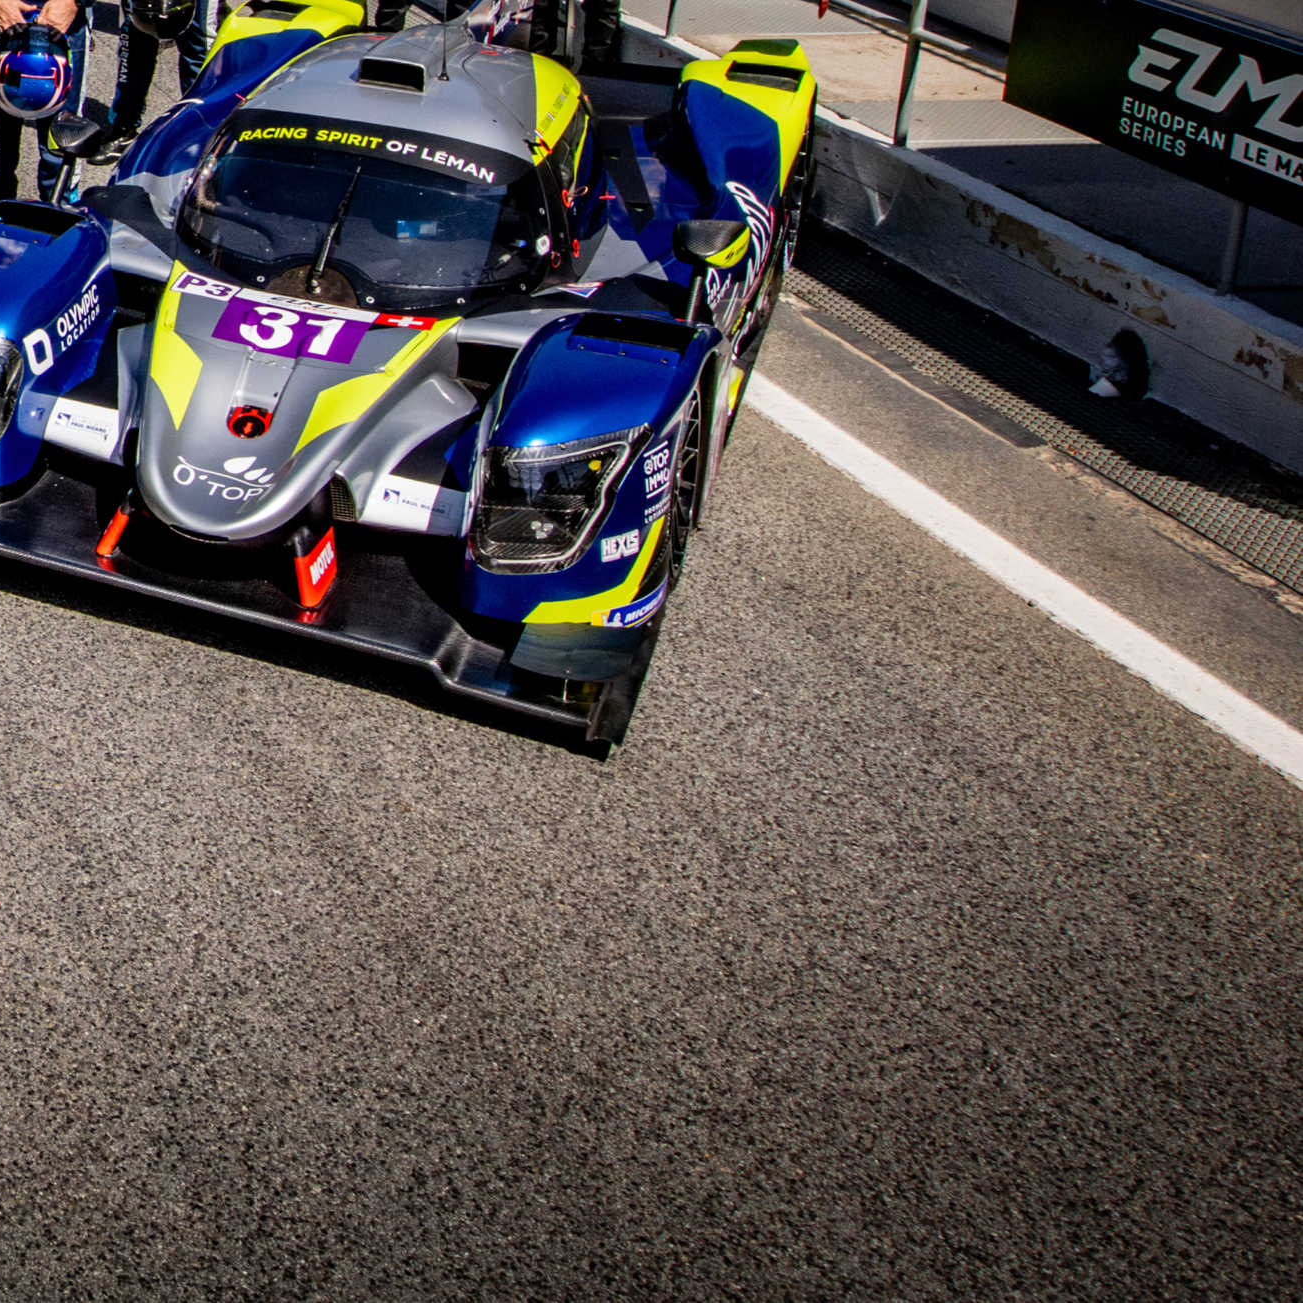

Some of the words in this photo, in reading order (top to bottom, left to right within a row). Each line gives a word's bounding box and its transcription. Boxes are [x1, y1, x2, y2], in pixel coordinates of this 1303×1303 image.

[238, 126, 309, 143] RACING
[314, 129, 383, 150] SPIRIT
[384, 140, 419, 157] OF
[1118, 117, 1187, 157] SERIES
[1121, 95, 1226, 151] EUROPEAN
[1243, 142, 1270, 167] LE
[176, 274, 234, 298] P3
[56, 283, 100, 339] OLYMPIC
[60, 303, 101, 353] LOCATION
[238, 305, 347, 357] 31
[308, 539, 335, 587] MOTUL
[602, 532, 640, 557] HEXIS
